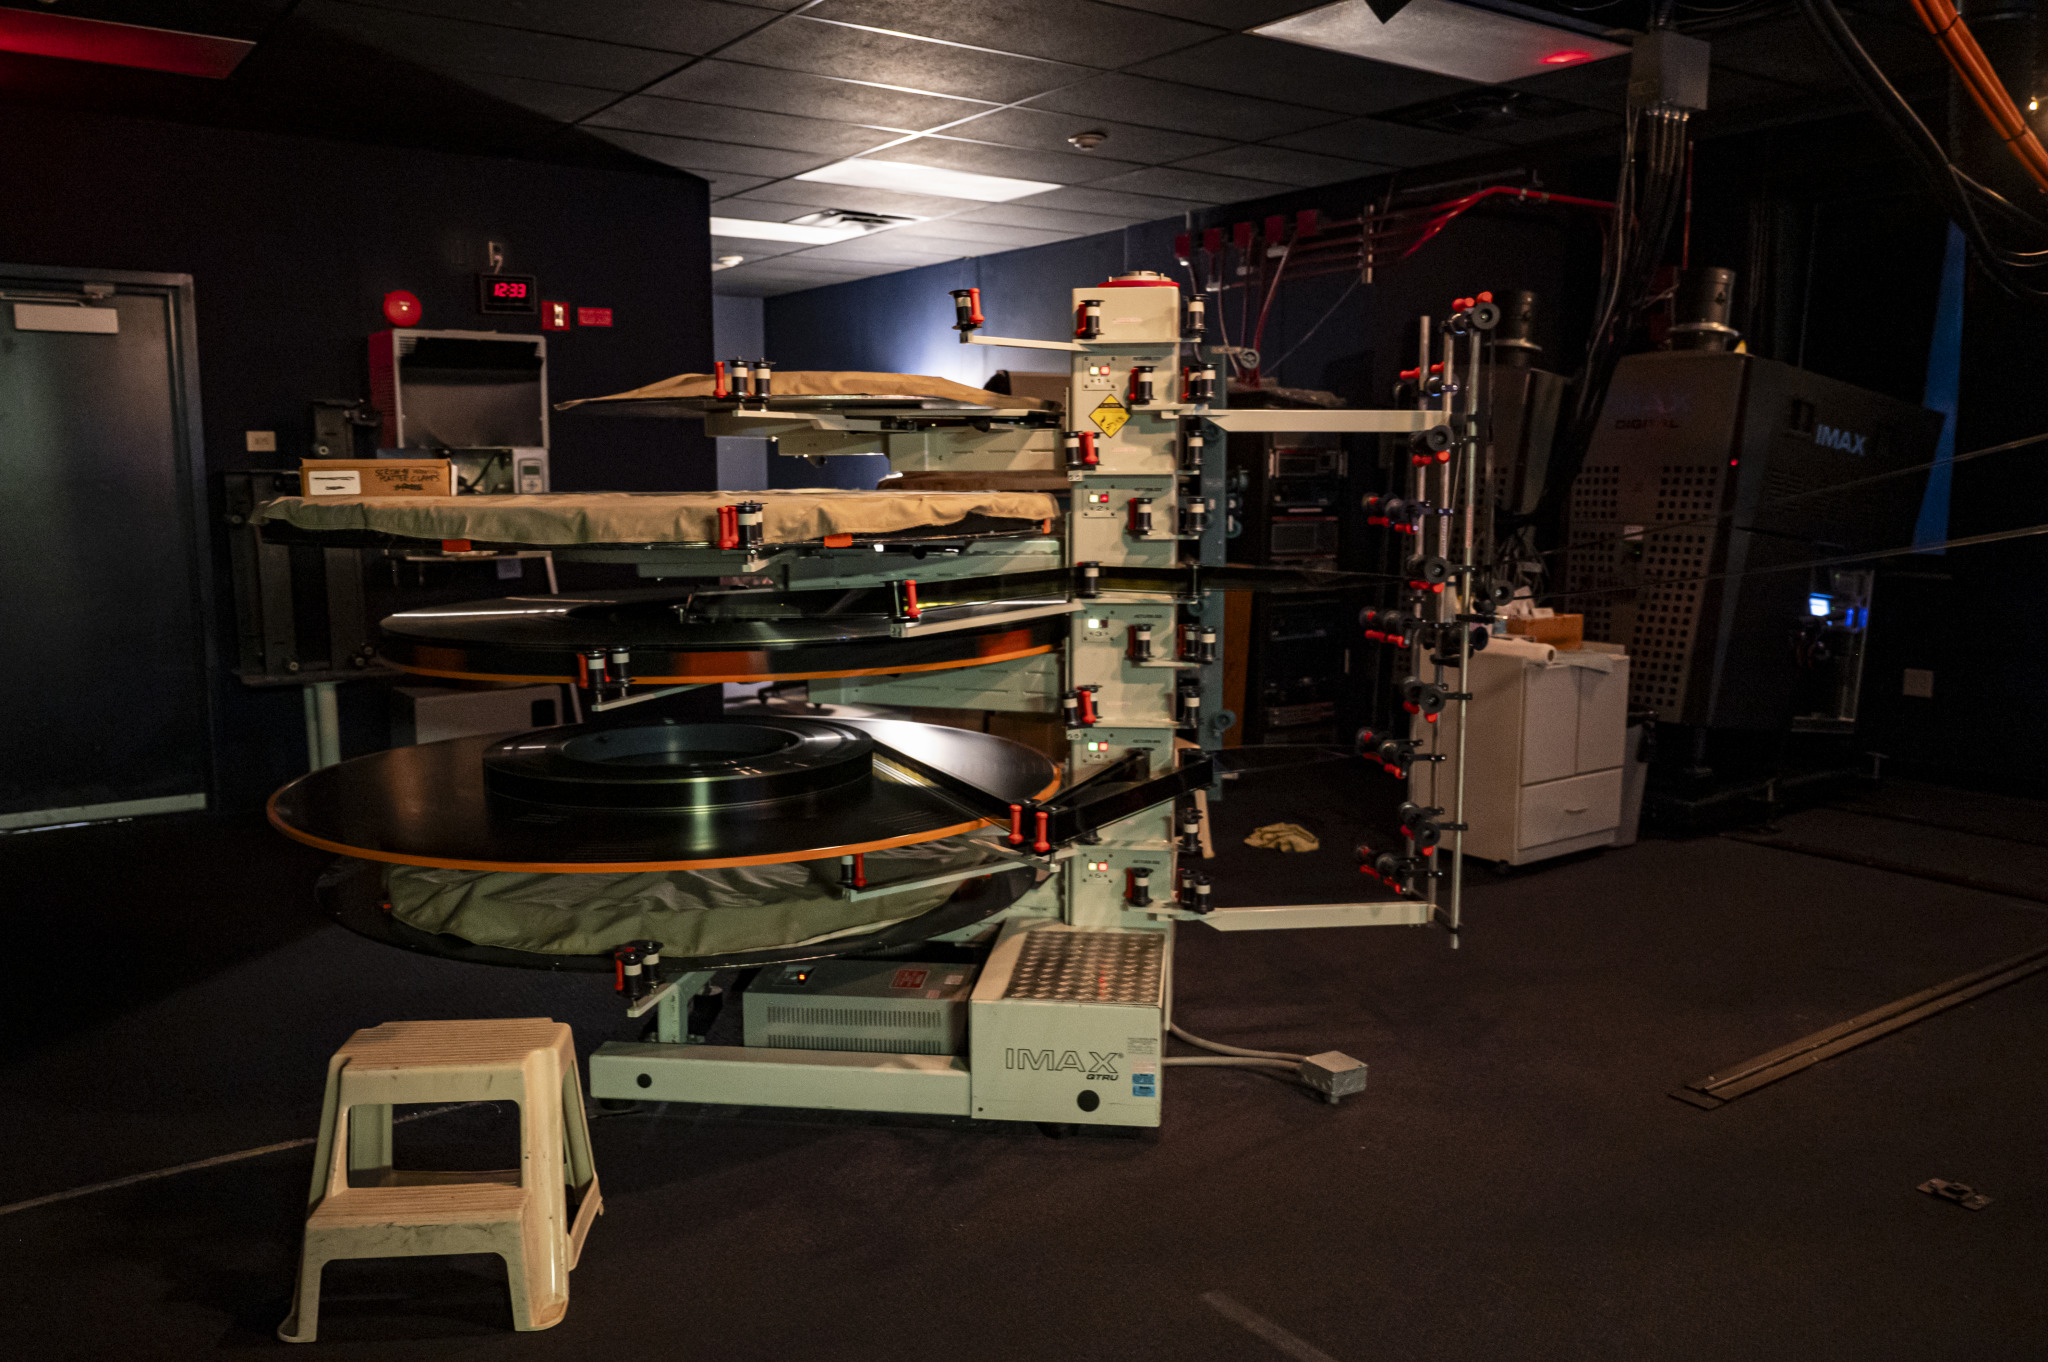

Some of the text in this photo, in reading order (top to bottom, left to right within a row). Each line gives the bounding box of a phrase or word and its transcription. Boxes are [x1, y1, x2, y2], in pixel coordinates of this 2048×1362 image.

[494, 282, 527, 298] 12:33
[1816, 424, 1867, 455] IMAX
[1005, 1048, 1118, 1074] IMAX
